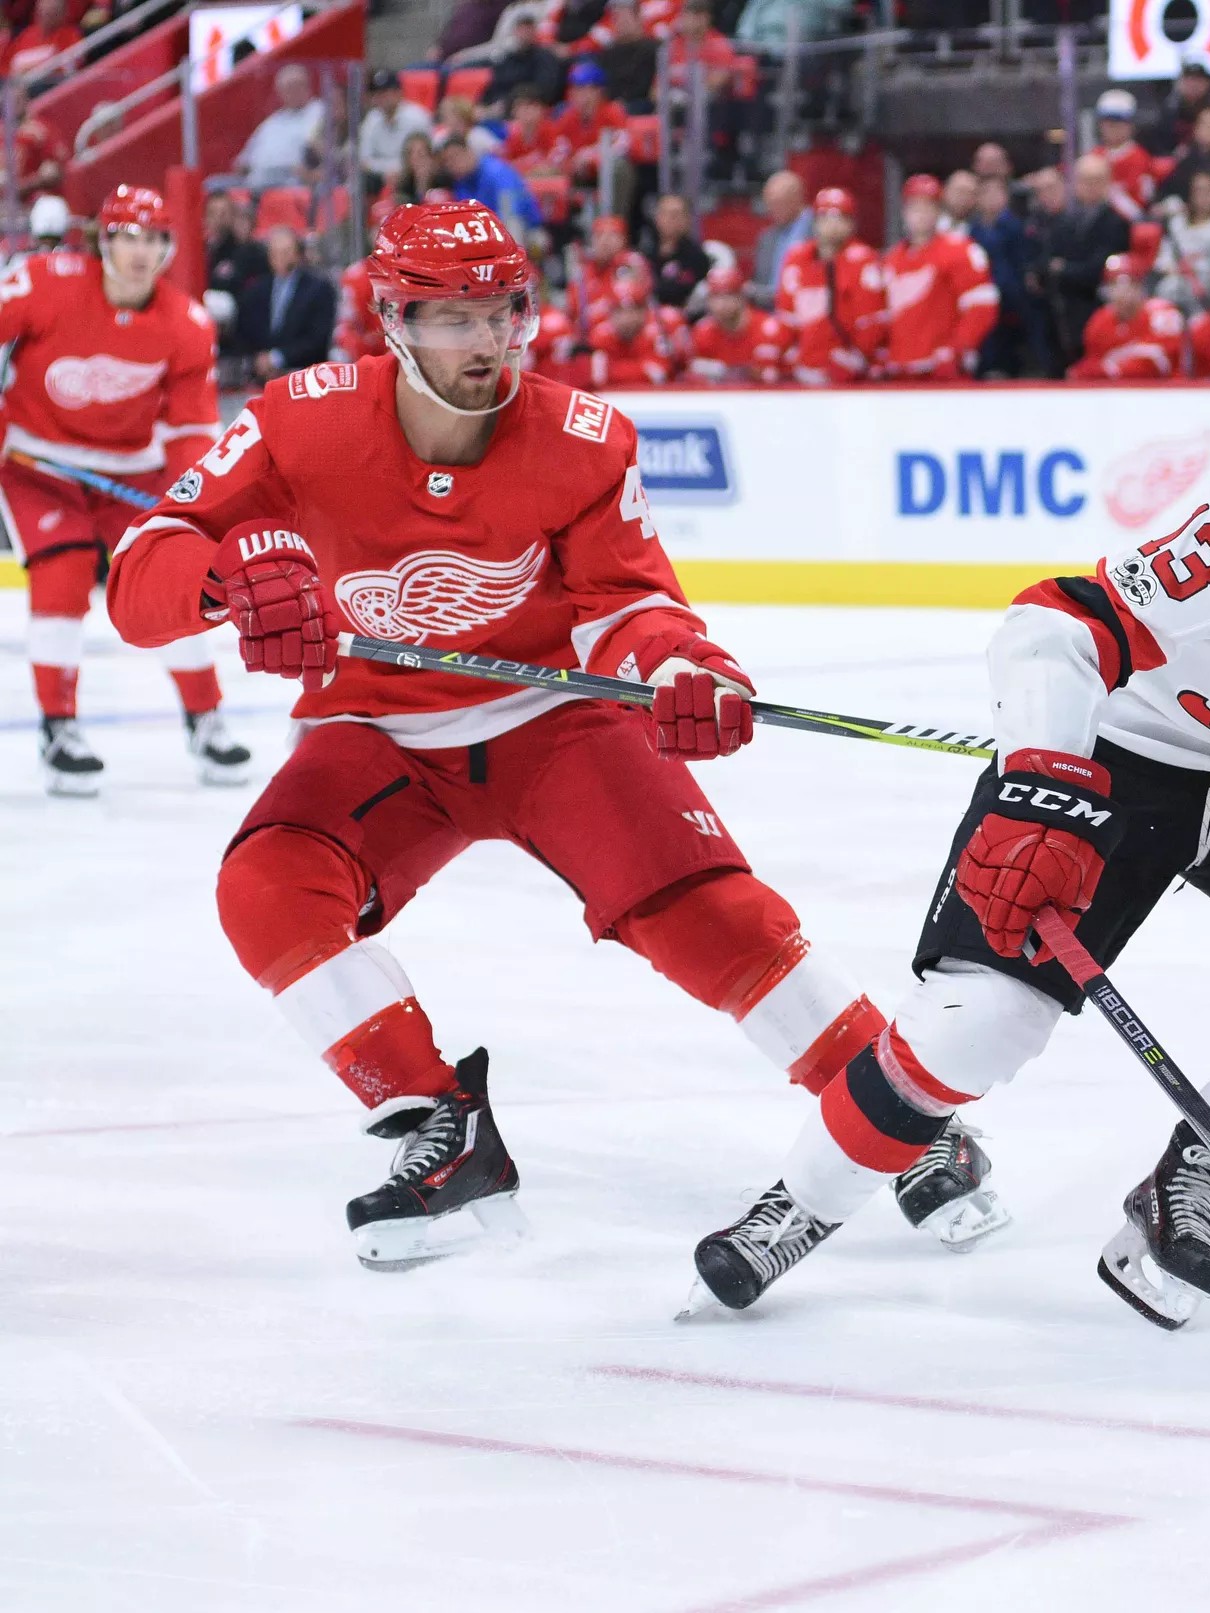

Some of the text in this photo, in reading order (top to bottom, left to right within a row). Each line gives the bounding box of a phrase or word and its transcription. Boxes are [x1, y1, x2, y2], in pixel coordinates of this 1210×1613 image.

[453, 220, 489, 243] 43
[196, 407, 263, 478] 3
[896, 450, 1086, 518] DMC
[1052, 761, 1093, 779] HISCHIER
[998, 782, 1113, 828] CCM
[1149, 1187, 1160, 1225] CCM
